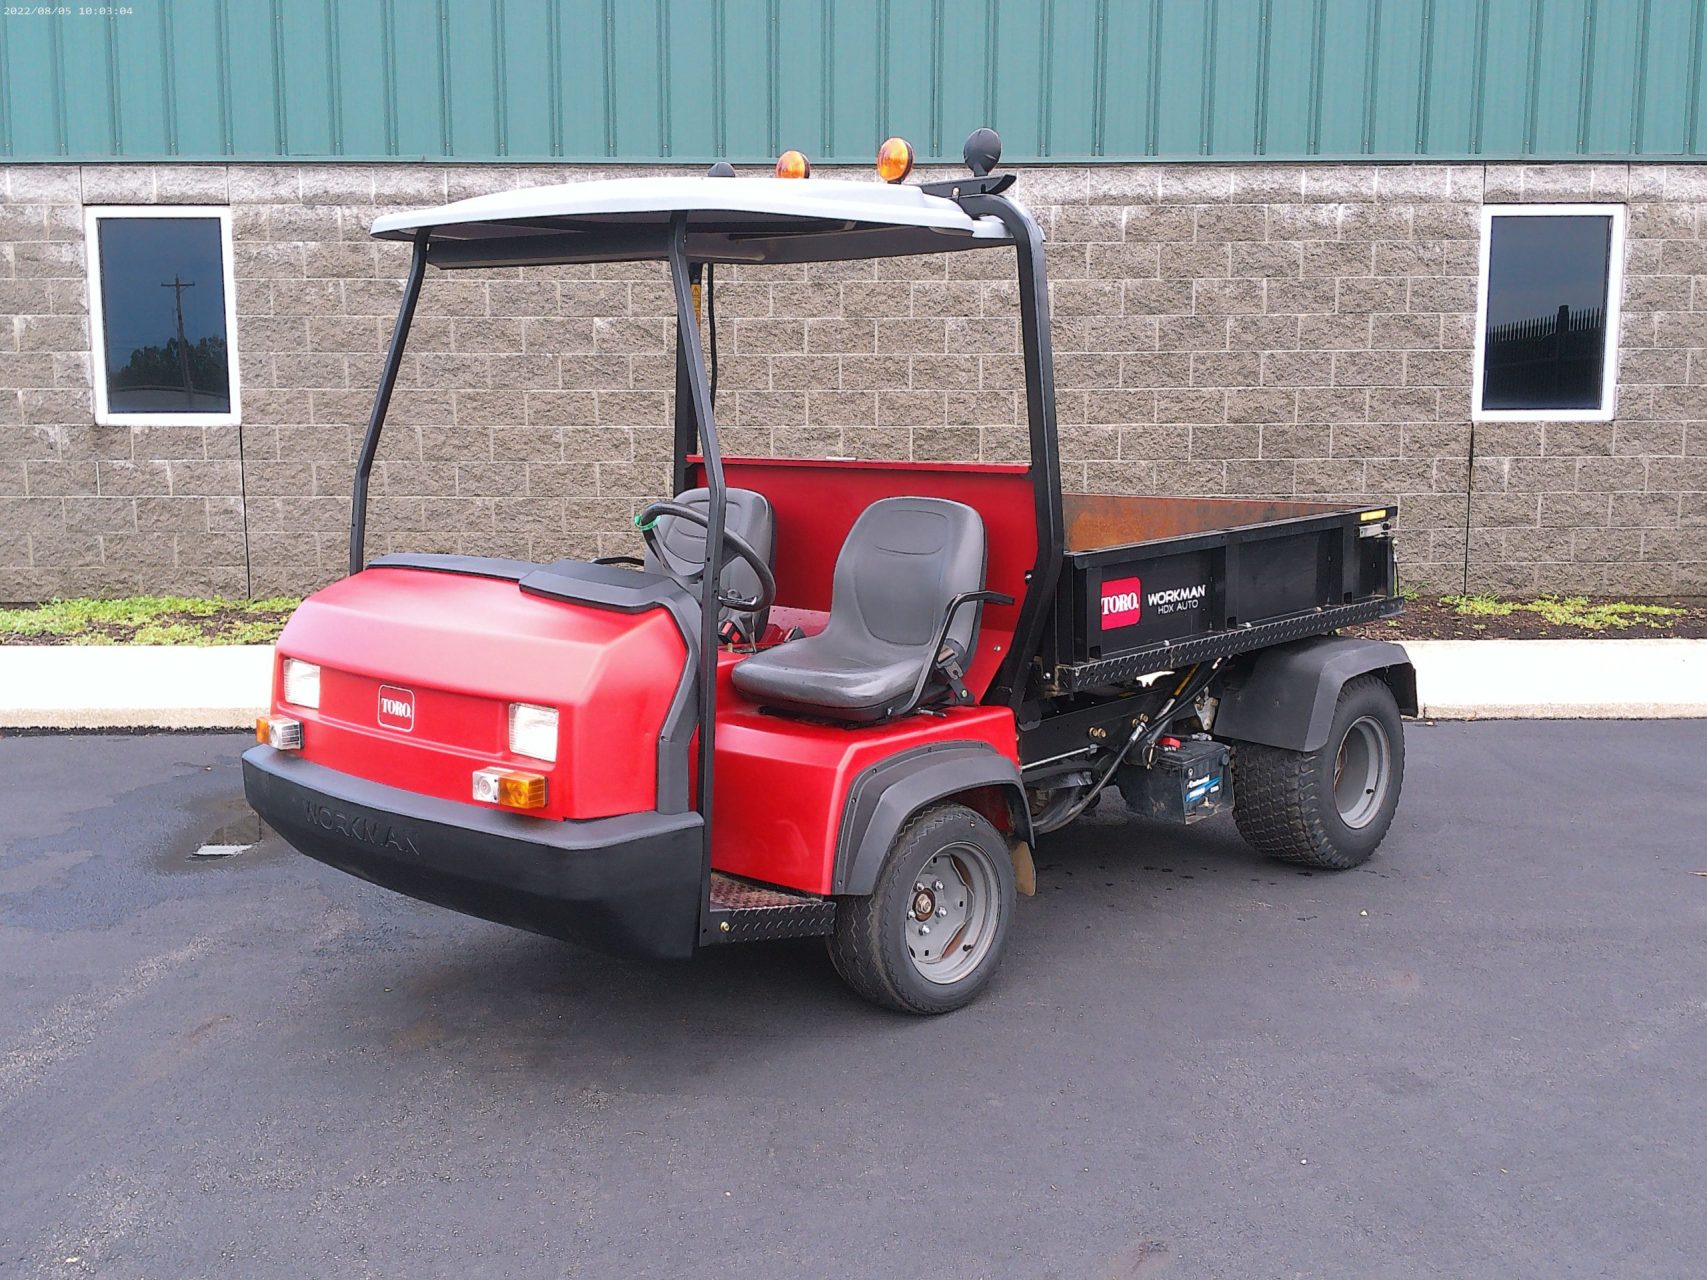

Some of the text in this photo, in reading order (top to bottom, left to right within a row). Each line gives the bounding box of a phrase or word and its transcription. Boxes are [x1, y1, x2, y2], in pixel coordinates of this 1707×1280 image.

[1147, 584, 1206, 606] WORKMAN
[1157, 599, 1199, 615] HDX AUTO
[303, 798, 420, 855] WORKMAN
